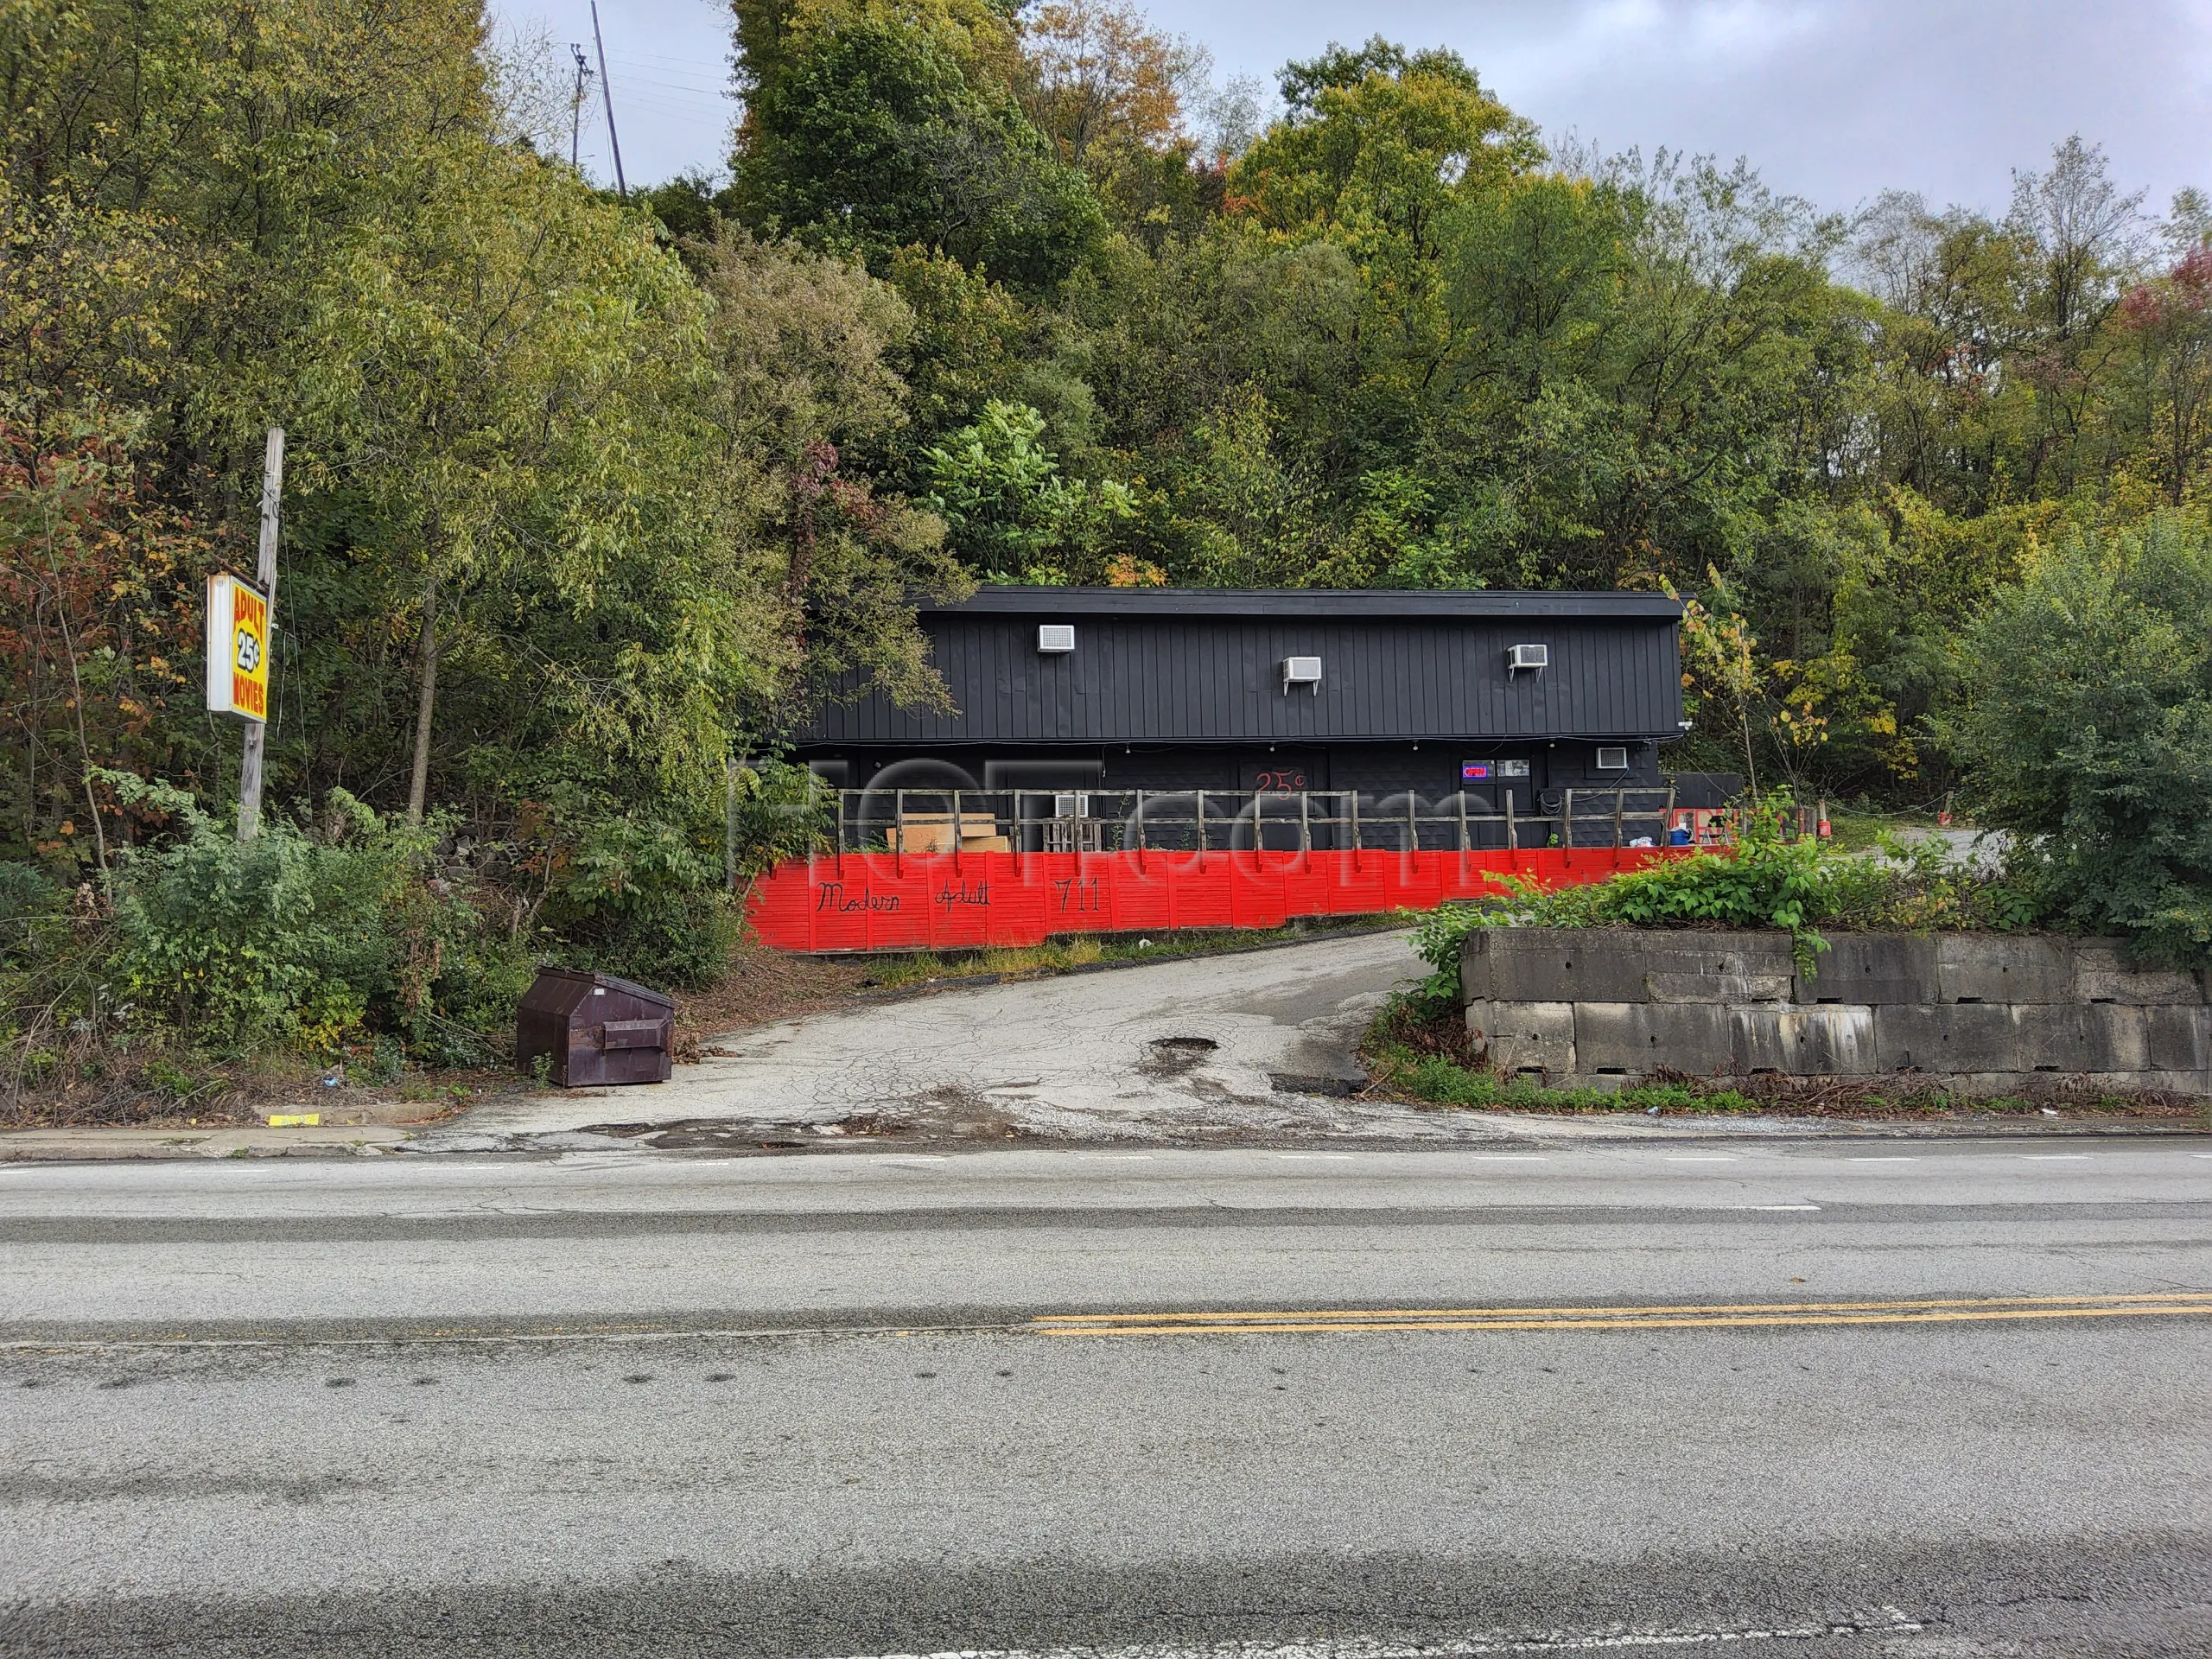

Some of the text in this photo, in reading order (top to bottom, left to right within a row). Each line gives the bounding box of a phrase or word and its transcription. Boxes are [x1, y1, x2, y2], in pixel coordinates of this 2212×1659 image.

[233, 586, 264, 645] ADULT
[233, 671, 264, 715] MOVIES
[1464, 766, 1486, 778] OPEN
[816, 875, 1100, 914] Modern Adult 711
